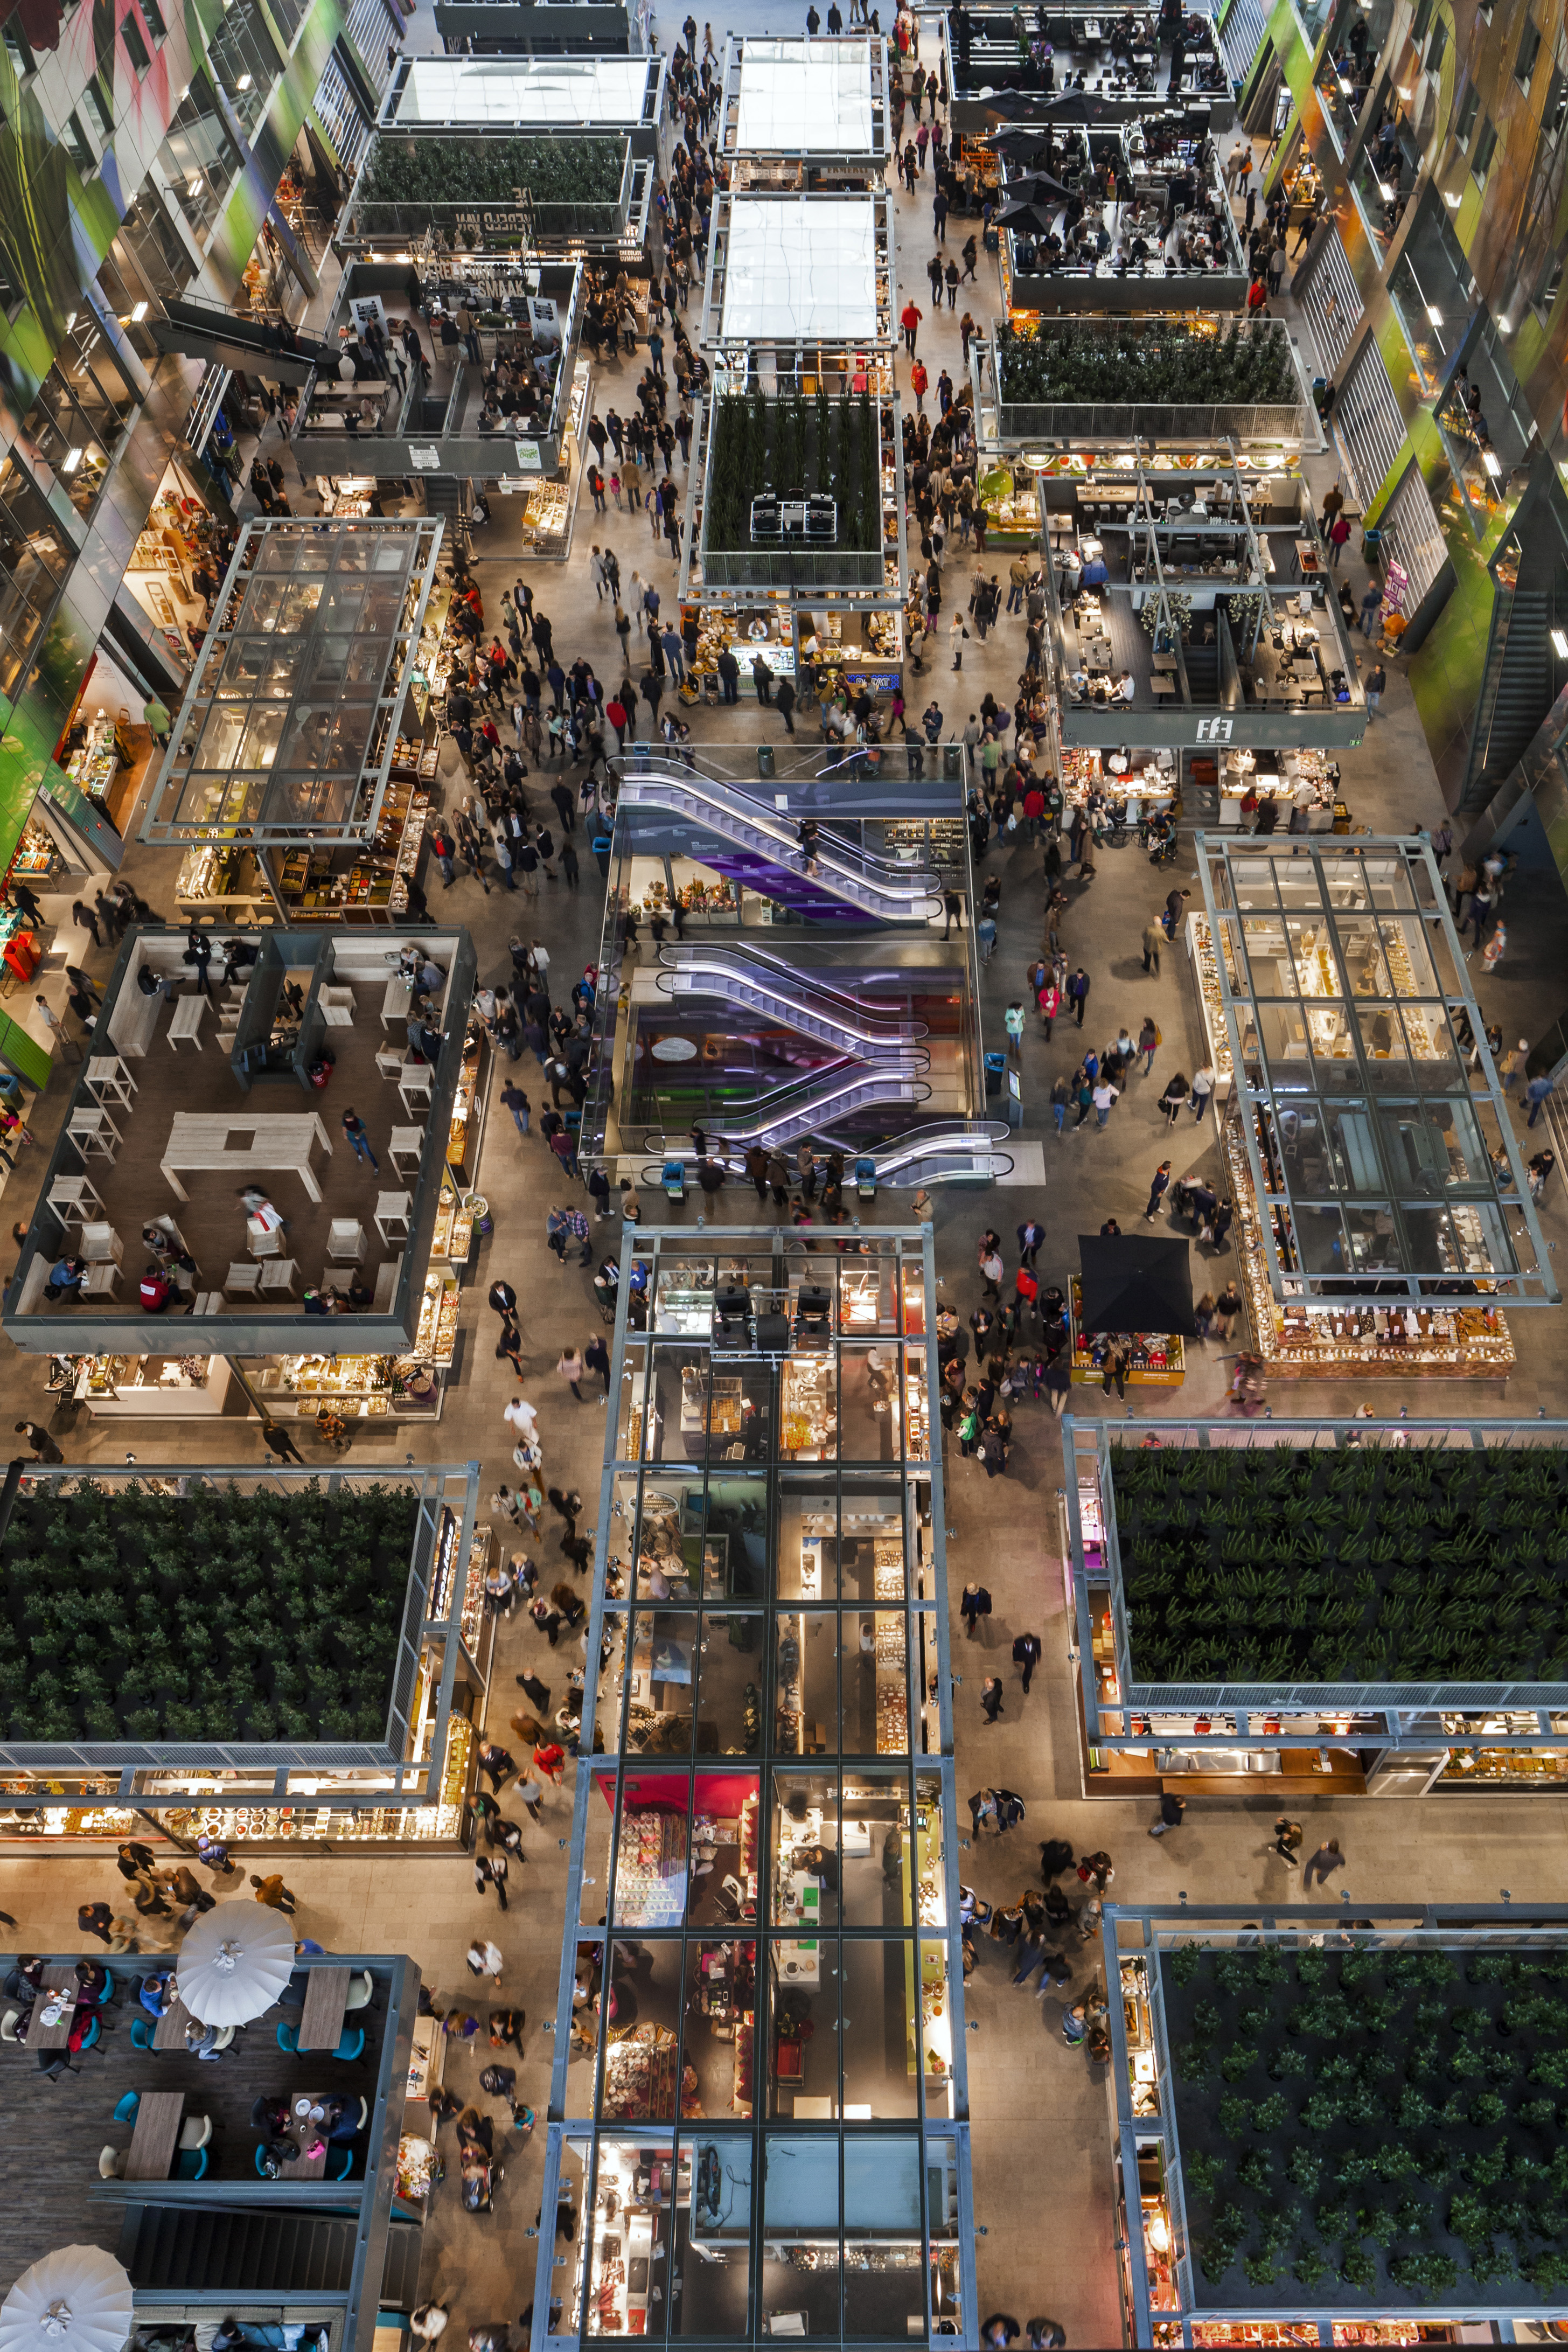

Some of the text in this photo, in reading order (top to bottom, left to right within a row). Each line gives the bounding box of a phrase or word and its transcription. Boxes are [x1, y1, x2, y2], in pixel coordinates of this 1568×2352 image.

[413, 263, 495, 281] WERELD VAN
[477, 280, 526, 297] SMAAK
